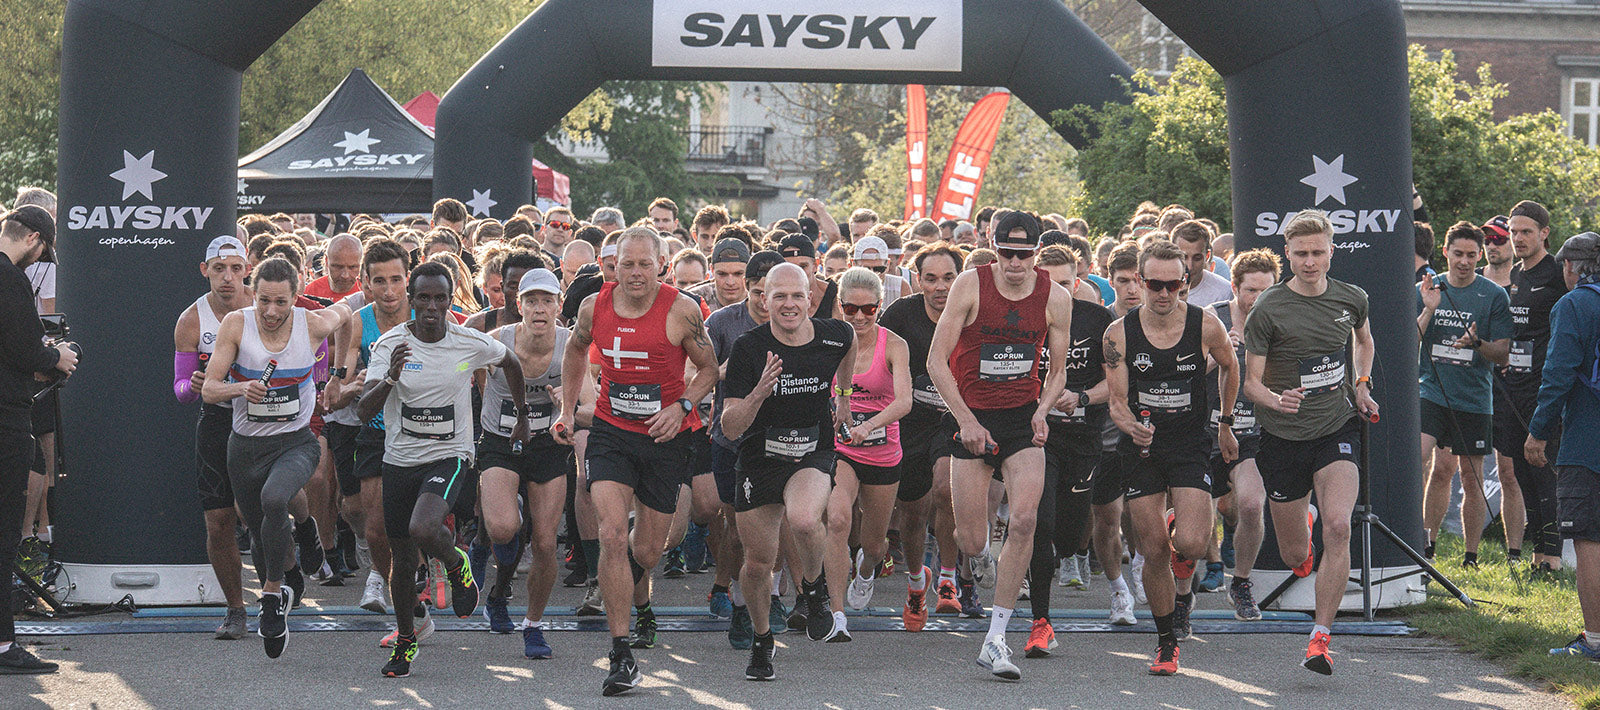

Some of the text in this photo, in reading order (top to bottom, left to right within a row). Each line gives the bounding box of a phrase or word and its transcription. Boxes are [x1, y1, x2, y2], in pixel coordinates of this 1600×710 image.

[680, 12, 937, 50] SAYSKY
[288, 153, 425, 170] SAYSKY
[940, 151, 981, 222] LIF
[237, 195, 266, 205] SKY
[67, 205, 214, 230] SAYSKY
[98, 234, 175, 249] copenhagen
[1176, 364, 1197, 372] NBRO
[1312, 360, 1341, 373] COP RUN
[780, 376, 819, 387] Distance
[781, 381, 829, 396] Running.dk
[274, 395, 289, 403] RUN
